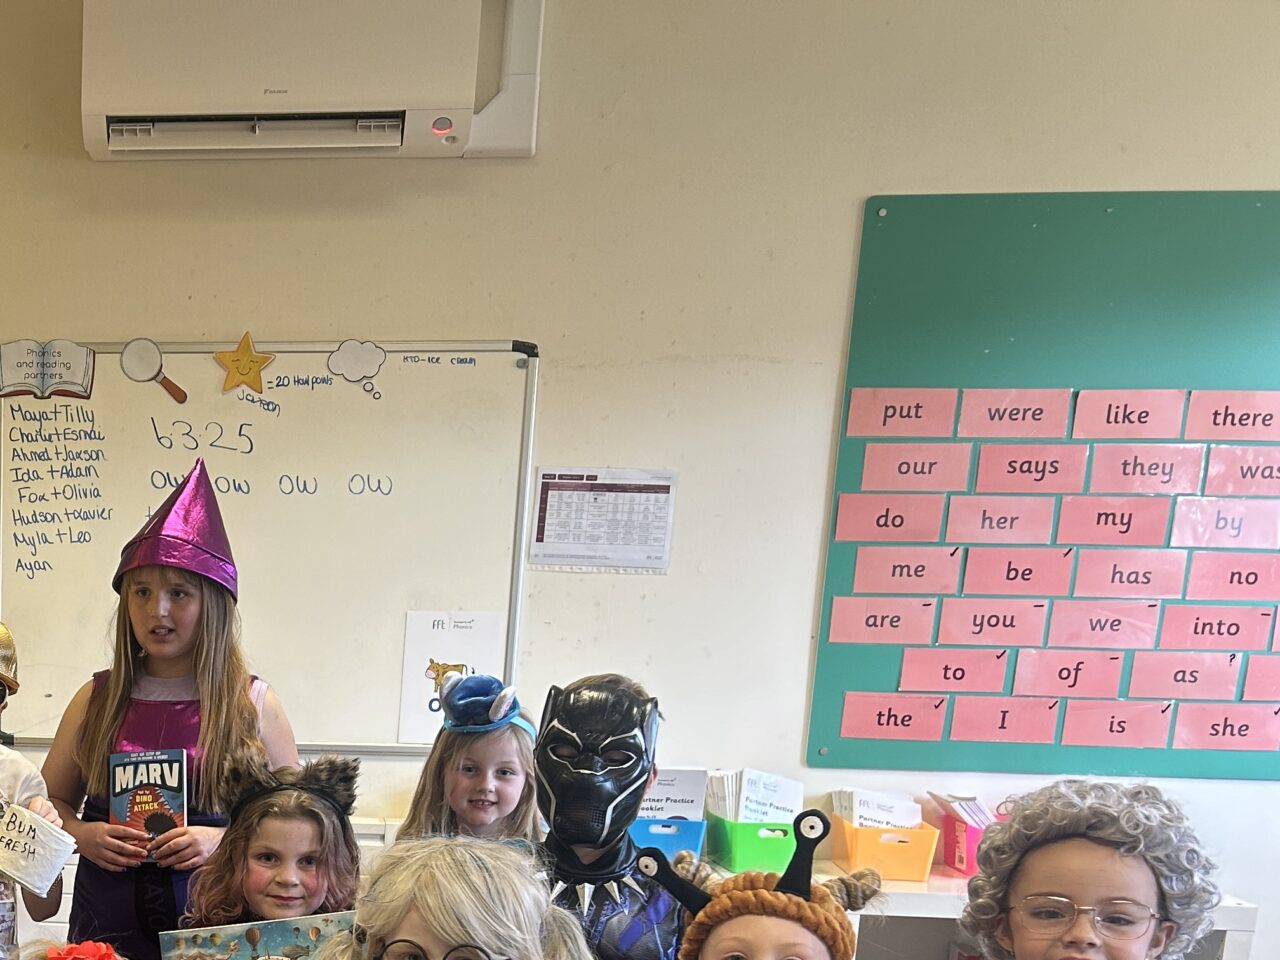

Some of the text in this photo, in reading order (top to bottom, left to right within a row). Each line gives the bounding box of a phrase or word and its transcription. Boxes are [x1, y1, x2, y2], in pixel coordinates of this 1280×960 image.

[26, 348, 62, 358] Phonics
[16, 359, 71, 370] and reading
[23, 372, 63, 380] partners
[882, 402, 923, 427] put
[987, 405, 1044, 422] were
[1105, 403, 1150, 426] like
[1211, 407, 1274, 428] there
[897, 460, 938, 476] our
[1006, 458, 1060, 481] says
[1121, 458, 1175, 483] they
[875, 508, 905, 528] do
[981, 510, 1019, 530] her
[1096, 510, 1133, 534] my
[1215, 511, 1244, 538] by
[891, 562, 926, 578] me
[1005, 562, 1033, 582] be
[1111, 564, 1152, 585] has
[1229, 570, 1259, 586] no
[864, 613, 902, 628] are
[971, 613, 1016, 638] you
[1088, 616, 1122, 632] we
[1192, 616, 1240, 637] into
[942, 663, 966, 680] to
[1057, 661, 1084, 688] of
[1173, 668, 1199, 684] as
[876, 708, 913, 728] the
[998, 710, 1008, 730] I
[1108, 714, 1127, 734] is
[1209, 718, 1250, 738] she
[115, 762, 179, 793] MARV
[133, 802, 158, 812] ATTACK
[135, 794, 153, 803] DINO
[665, 796, 695, 804] Practice
[6, 812, 37, 839] BUM
